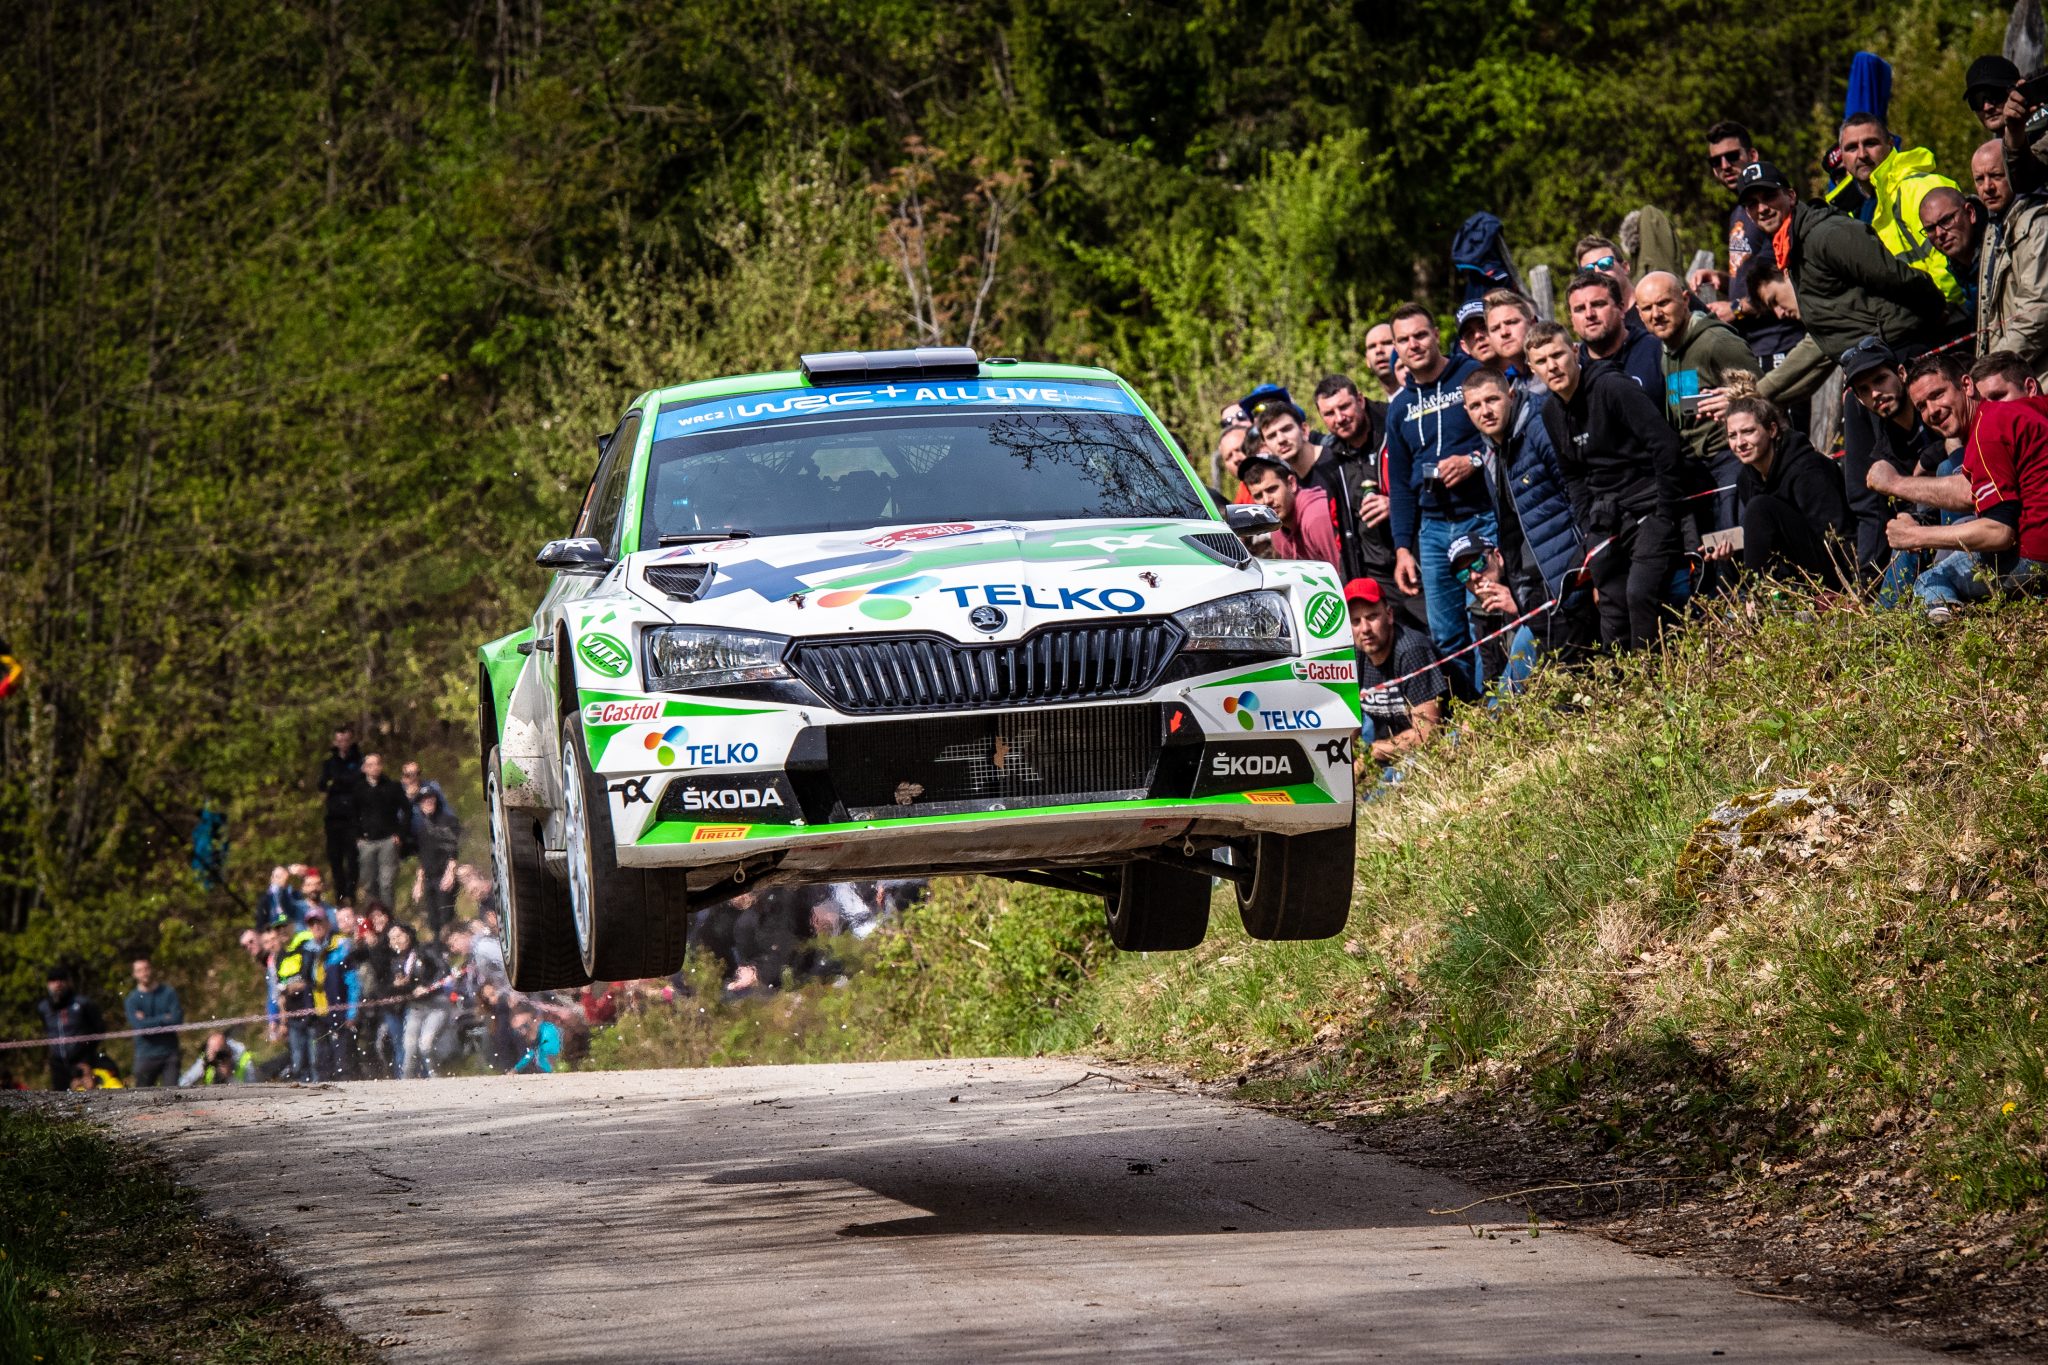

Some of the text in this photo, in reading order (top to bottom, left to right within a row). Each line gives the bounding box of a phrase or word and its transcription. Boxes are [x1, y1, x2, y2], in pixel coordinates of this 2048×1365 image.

[678, 411, 725, 427] WRC2
[915, 387, 979, 401] ALL
[986, 386, 1062, 402] LIVE
[939, 584, 1146, 613] TELKO
[582, 633, 629, 675] VIITA
[1308, 662, 1354, 680] Castrol
[602, 702, 661, 723] Castrol
[1260, 709, 1322, 731] TELKO
[686, 742, 759, 766] TELKO
[1212, 752, 1292, 776] ŠKODA
[683, 786, 784, 811] ŠKODA
[1247, 792, 1291, 803] PIRELLI
[695, 827, 746, 840] PIRELLI
